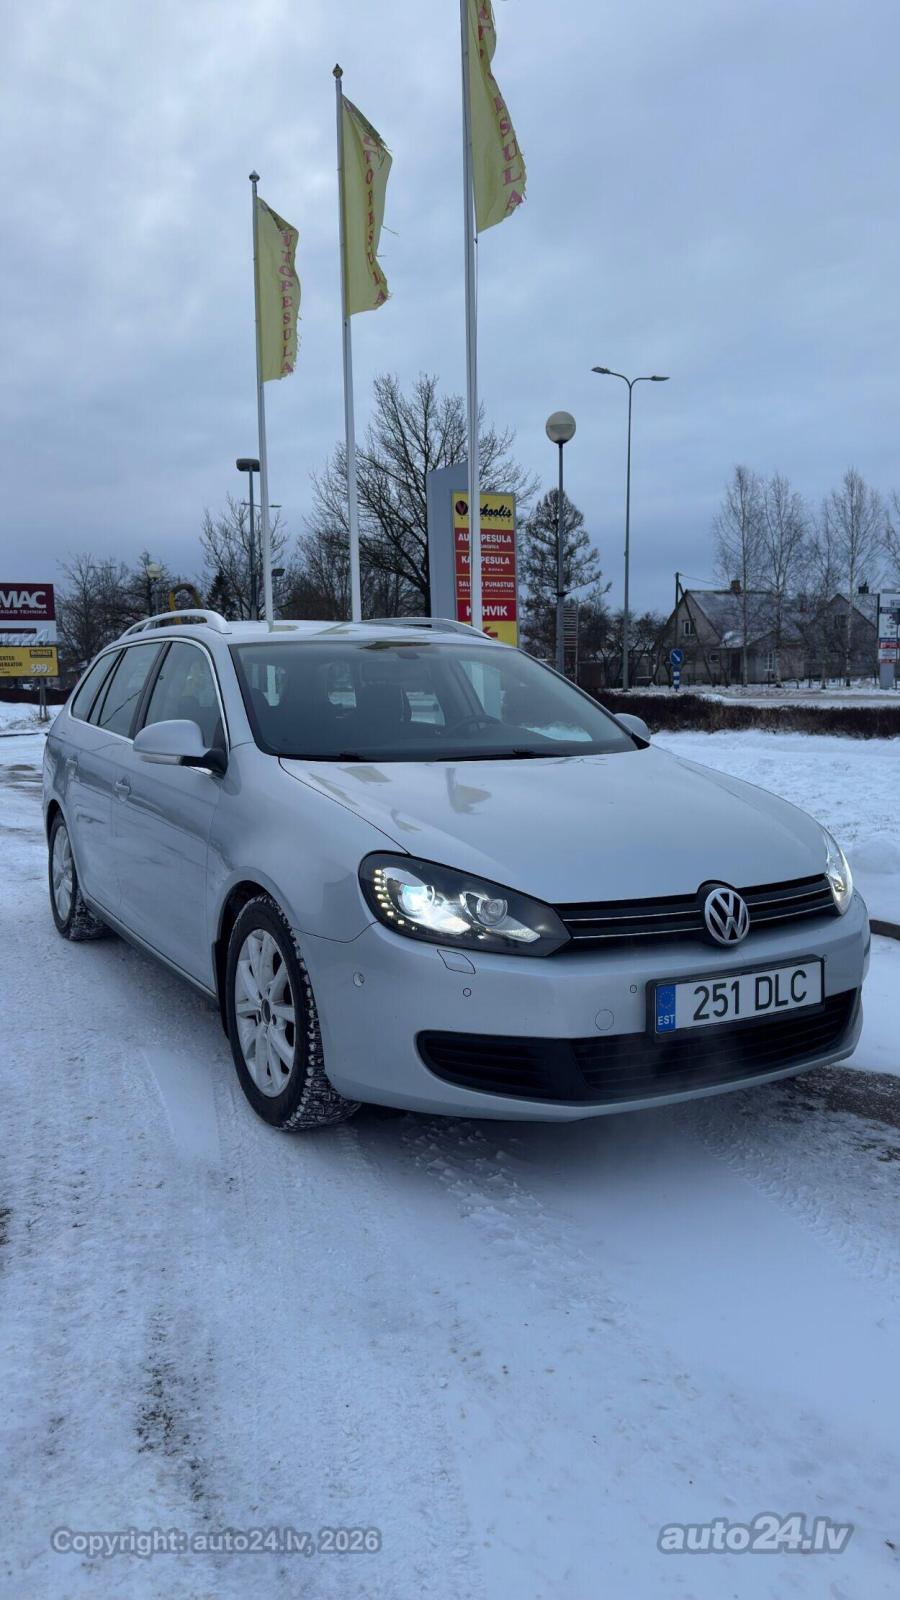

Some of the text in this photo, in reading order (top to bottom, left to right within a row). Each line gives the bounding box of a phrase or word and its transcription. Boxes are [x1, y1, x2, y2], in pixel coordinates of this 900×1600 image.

[458, 533, 512, 543] AUPESULA
[466, 605, 508, 617] KHVIK
[693, 969, 808, 1021] 251 DLC
[657, 1013, 676, 1026] EST
